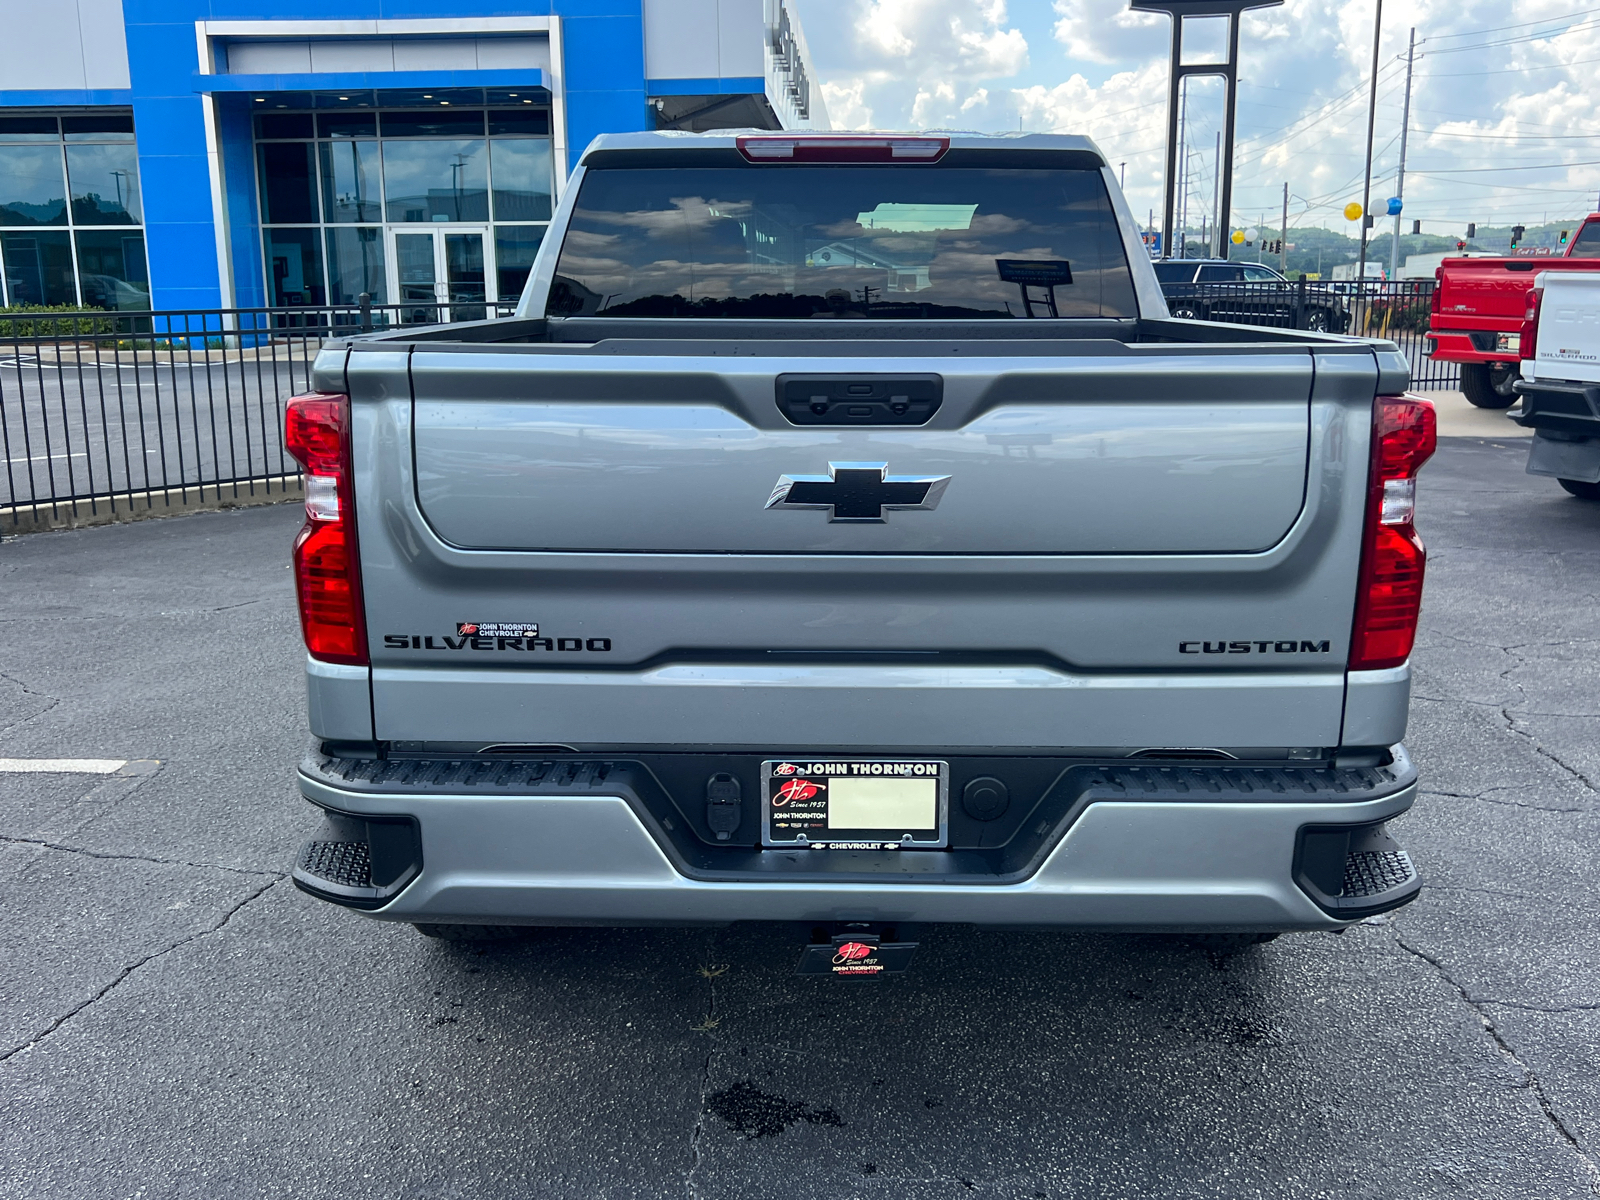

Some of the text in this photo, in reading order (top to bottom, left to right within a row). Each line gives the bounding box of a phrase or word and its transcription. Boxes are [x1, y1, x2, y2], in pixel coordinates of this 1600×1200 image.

[498, 623, 538, 631] THORNTON
[383, 634, 612, 652] SILVERADO
[1178, 639, 1331, 654] CUSTOM
[805, 763, 938, 775] JOHN THORNTON
[829, 842, 882, 850] CHEVROLET
